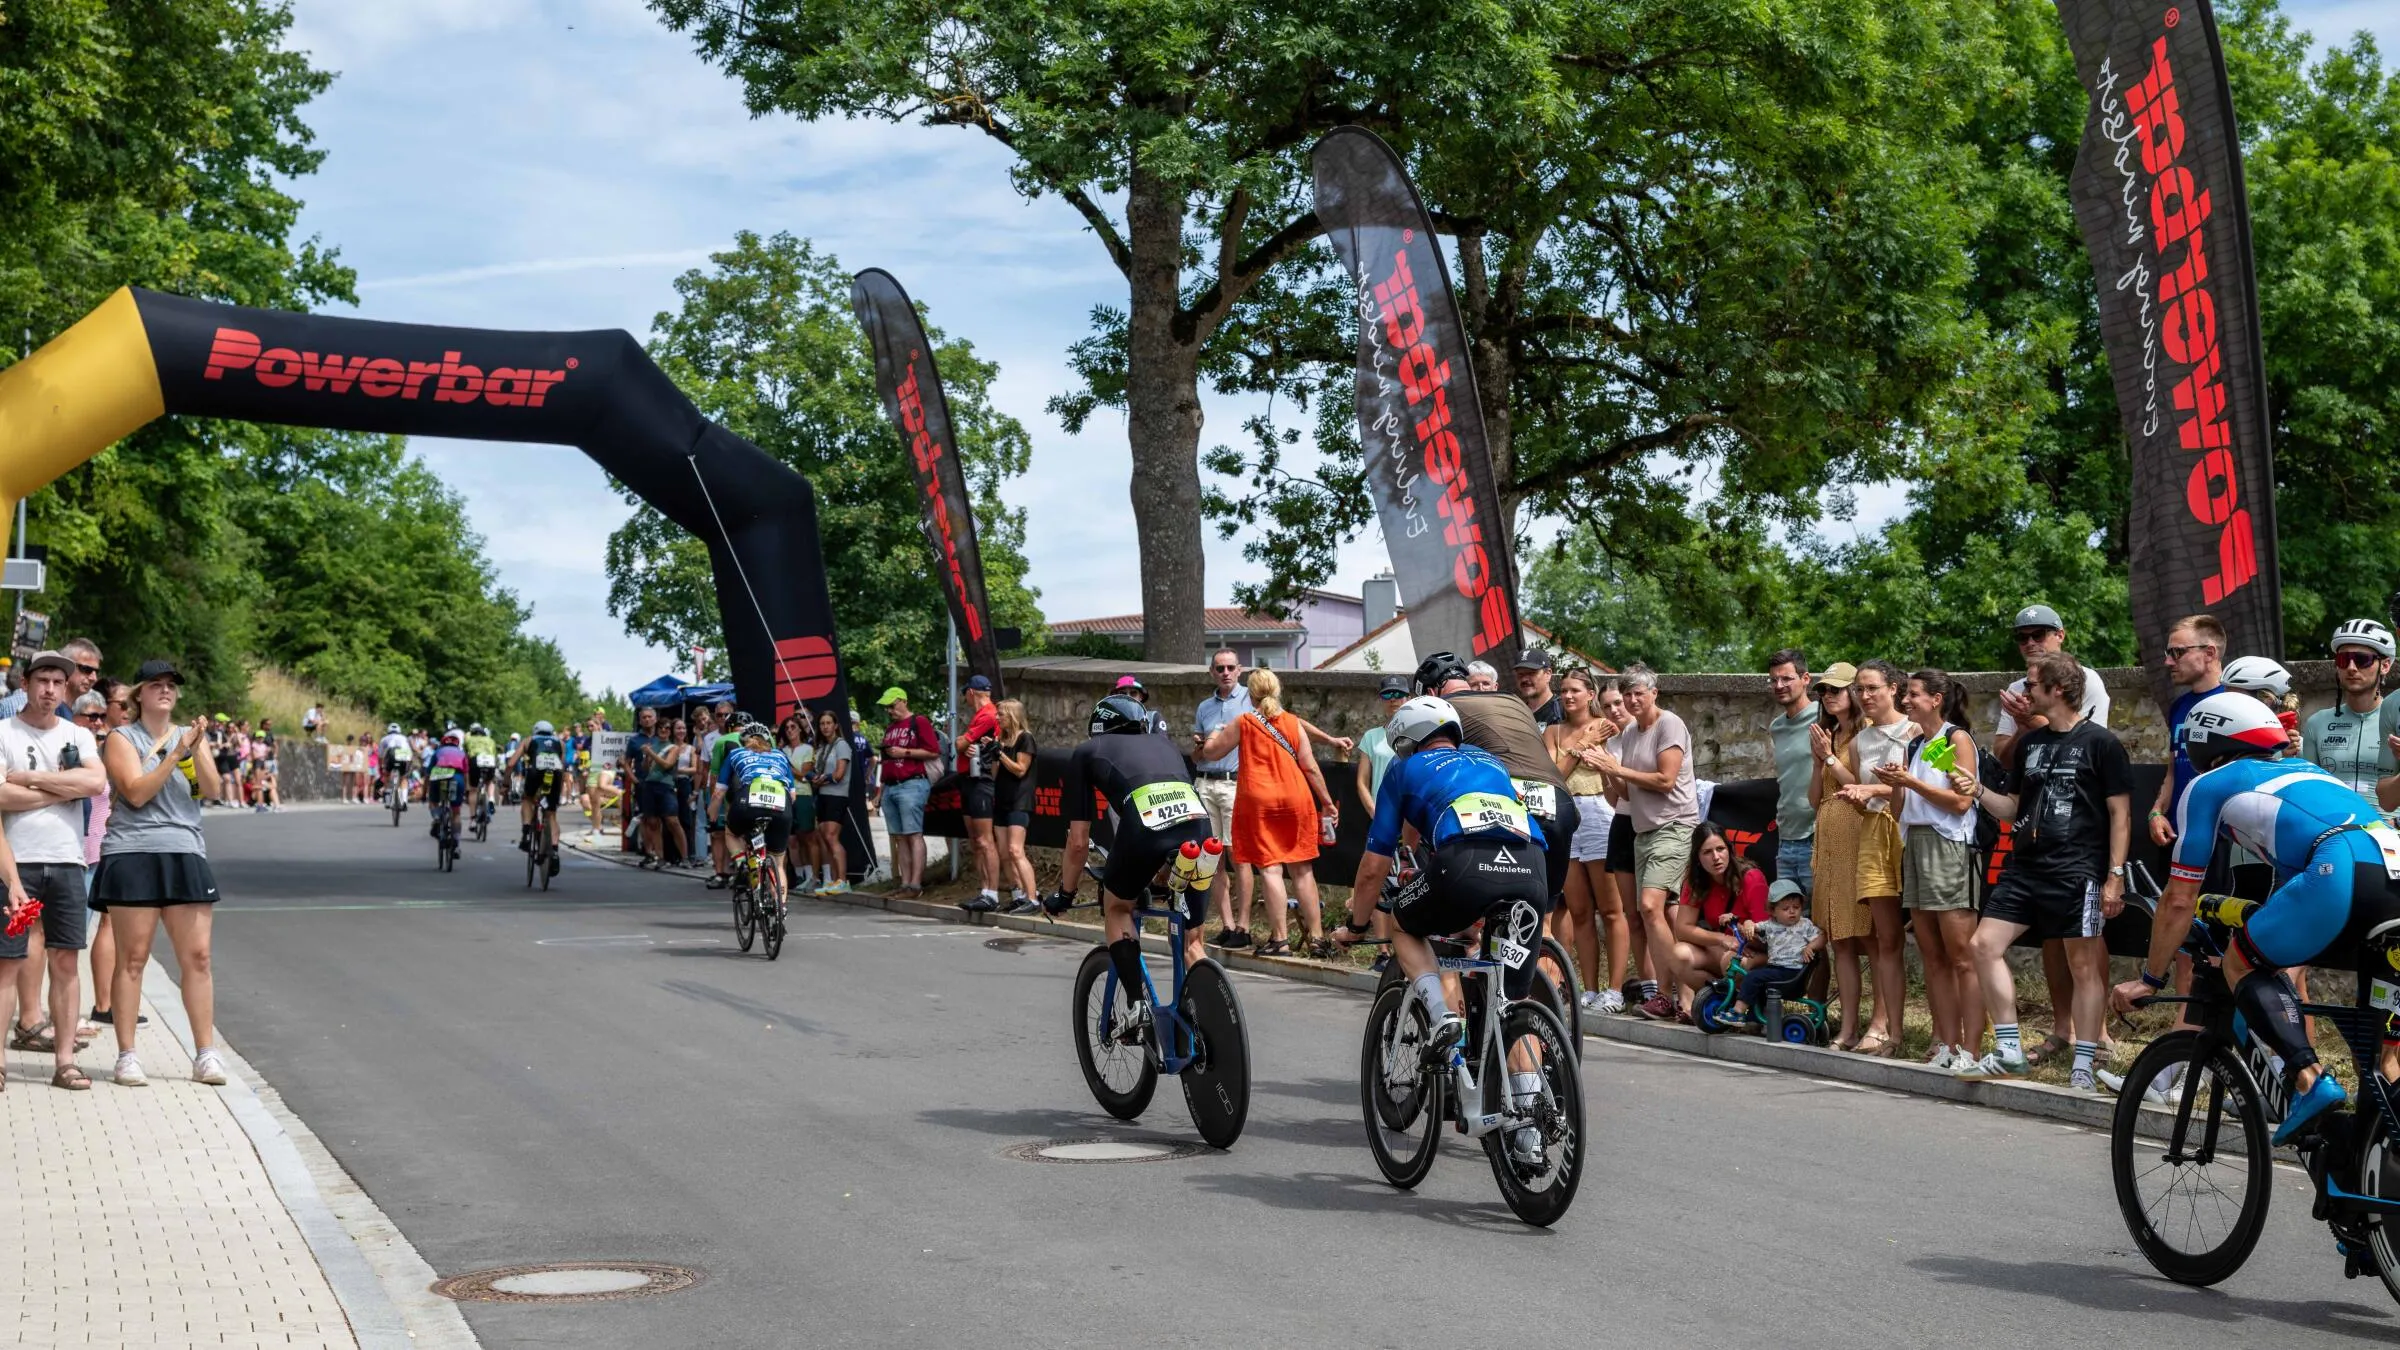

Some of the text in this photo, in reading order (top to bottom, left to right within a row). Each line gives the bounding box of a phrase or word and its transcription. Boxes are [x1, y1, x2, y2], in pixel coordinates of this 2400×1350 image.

[1094, 706, 1120, 720] MET
[2187, 711, 2233, 729] MET
[1148, 789, 1187, 807] Alexander
[1479, 799, 1502, 810] Sven
[1157, 803, 1191, 820] 4242
[1479, 809, 1514, 826] 4530
[1478, 863, 1532, 875] ElbAthleten
[1482, 1116, 1496, 1127] P2
